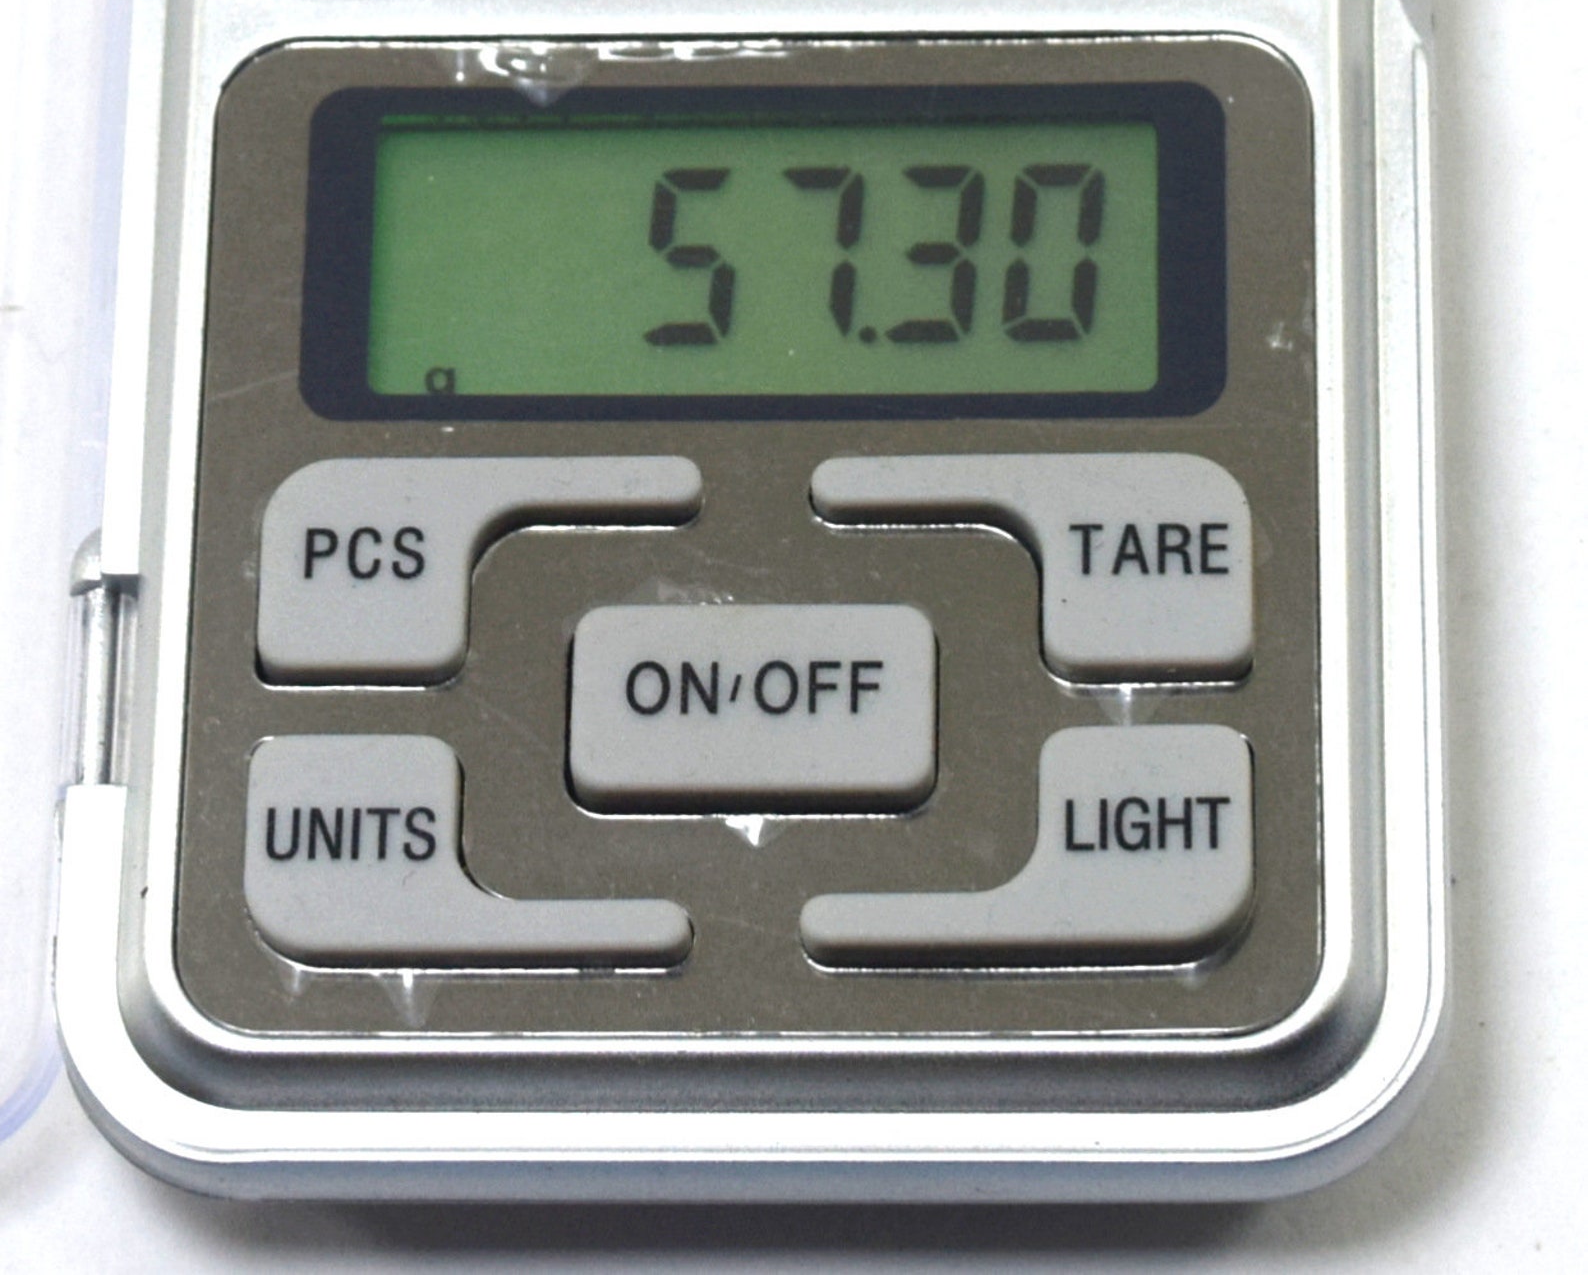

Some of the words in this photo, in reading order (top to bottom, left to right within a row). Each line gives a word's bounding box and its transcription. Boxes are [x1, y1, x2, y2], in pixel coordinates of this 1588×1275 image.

[645, 163, 1106, 347] 57.30
[303, 526, 426, 580] PCS
[1069, 523, 1230, 576] TARE
[625, 660, 884, 715] ON/OFF
[266, 806, 437, 862] UNITS
[1064, 796, 1231, 852] LIGHT
